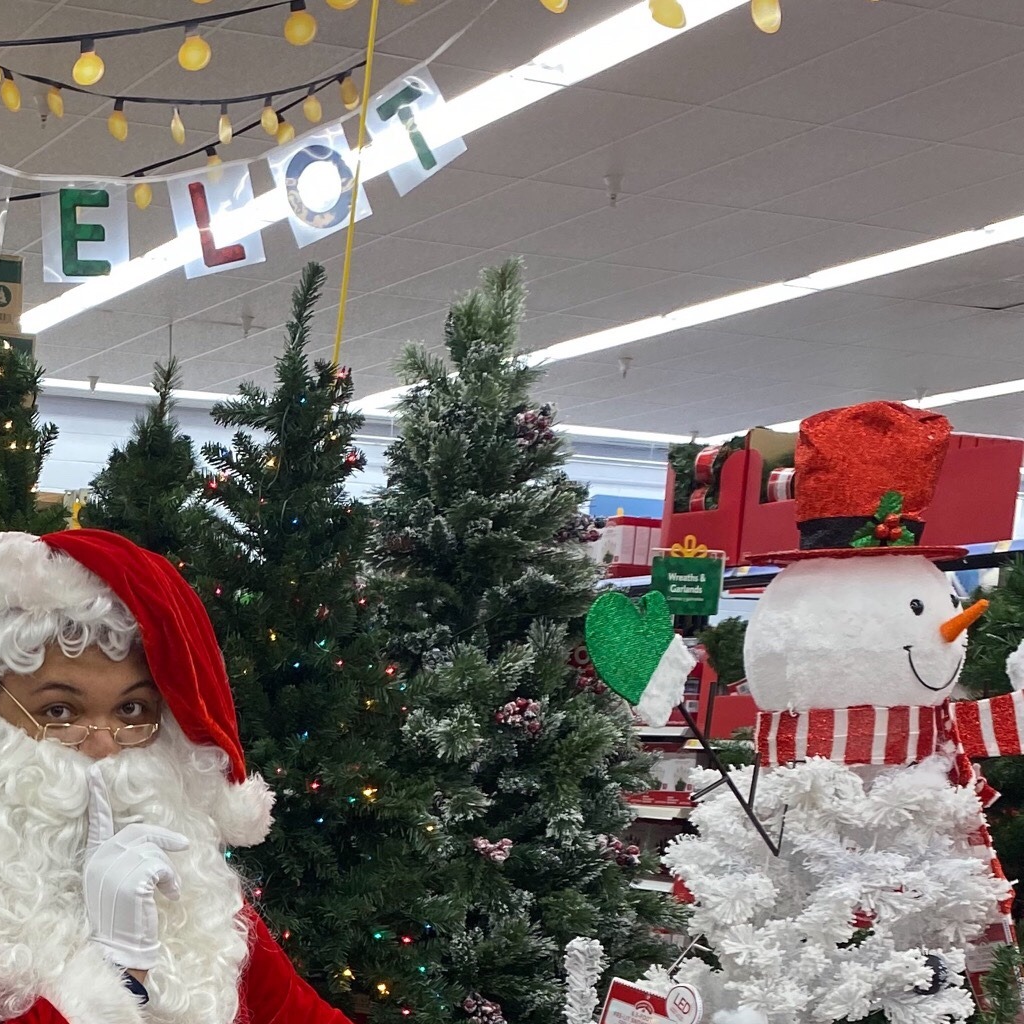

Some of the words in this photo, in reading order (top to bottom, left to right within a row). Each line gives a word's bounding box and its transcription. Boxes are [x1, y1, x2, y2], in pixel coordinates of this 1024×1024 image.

[668, 572, 699, 582] Wreaths
[700, 573, 707, 582] &
[669, 584, 703, 594] Garlands
[673, 992, 691, 1015] LED
